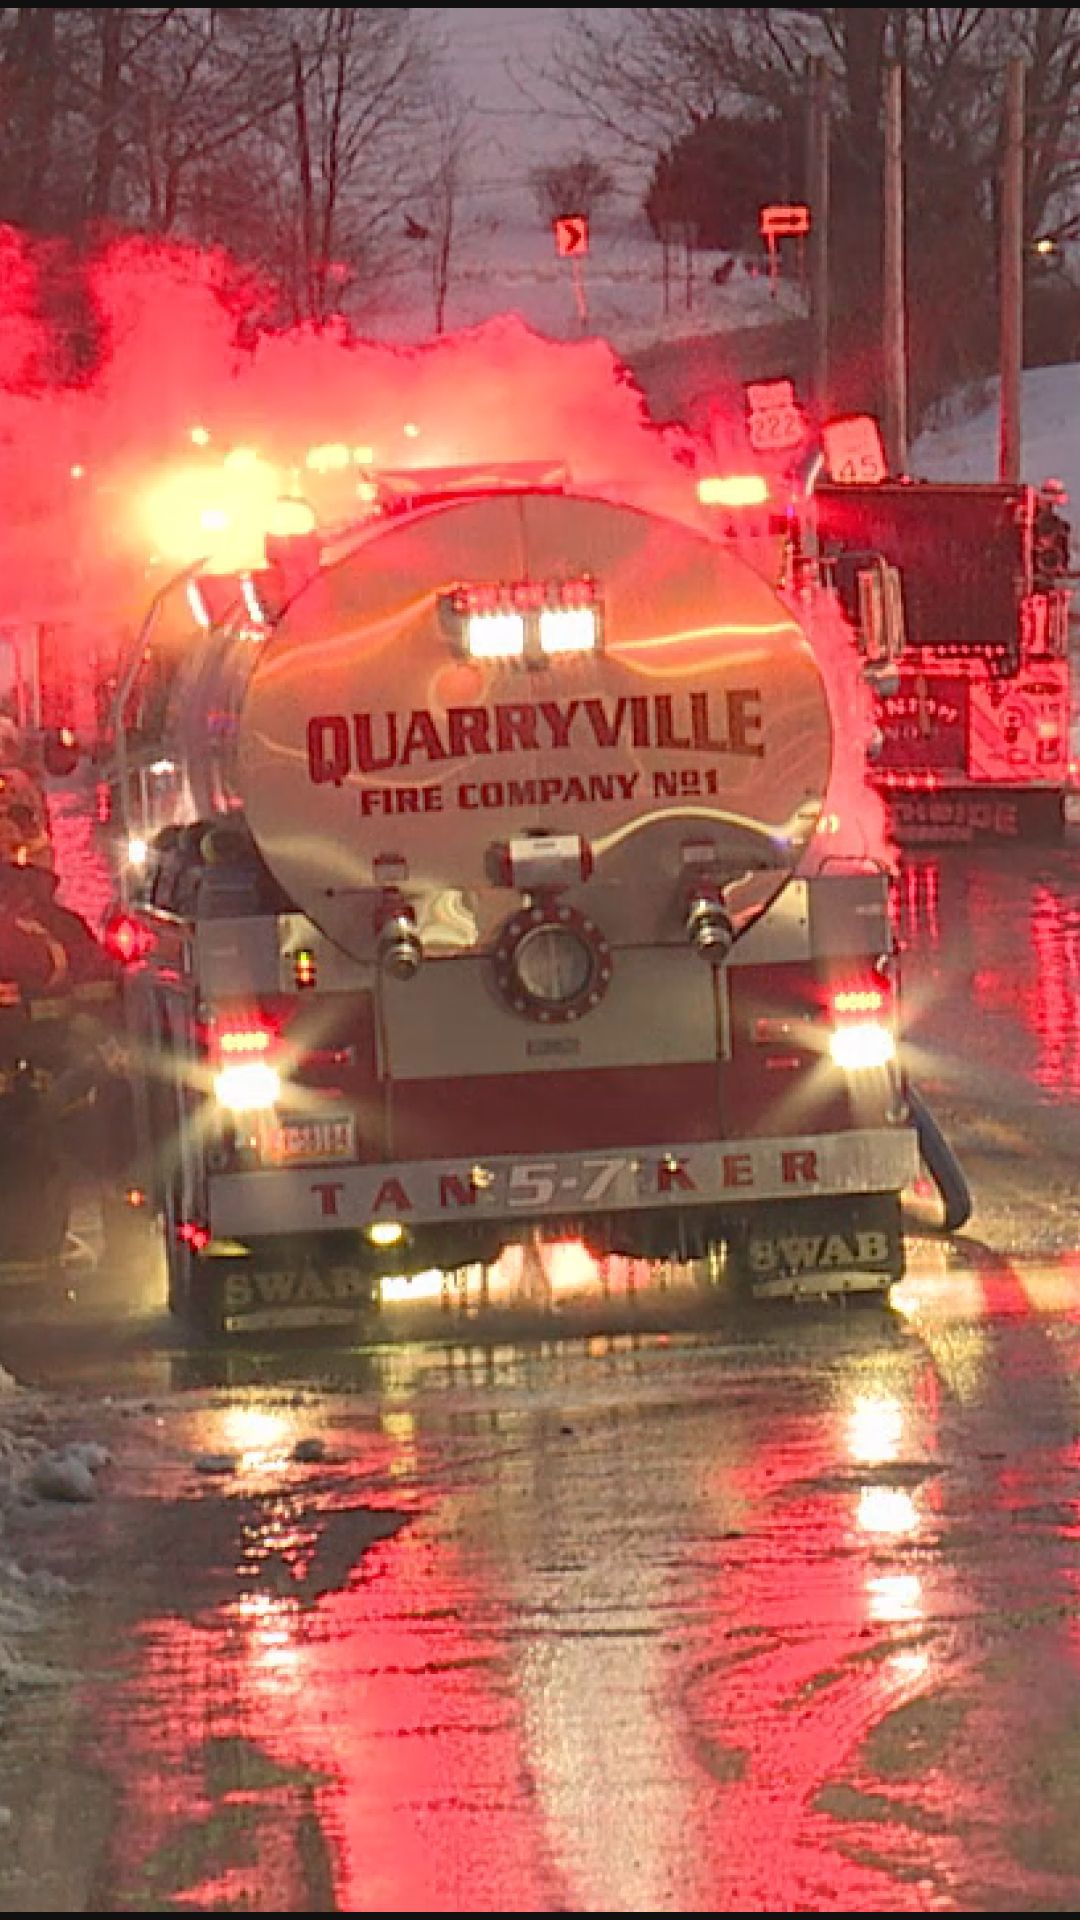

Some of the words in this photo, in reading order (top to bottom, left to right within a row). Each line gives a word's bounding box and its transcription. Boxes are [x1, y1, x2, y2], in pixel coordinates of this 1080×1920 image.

[754, 413, 796, 443] 222
[839, 454, 879, 478] 45
[307, 688, 766, 787] QUARRYVILLE
[360, 785, 444, 817] FIRE
[457, 772, 640, 810] COMPANY
[508, 1157, 627, 1207] 5-7
[750, 1231, 889, 1272] SWAB
[224, 1265, 364, 1305] SWAB
